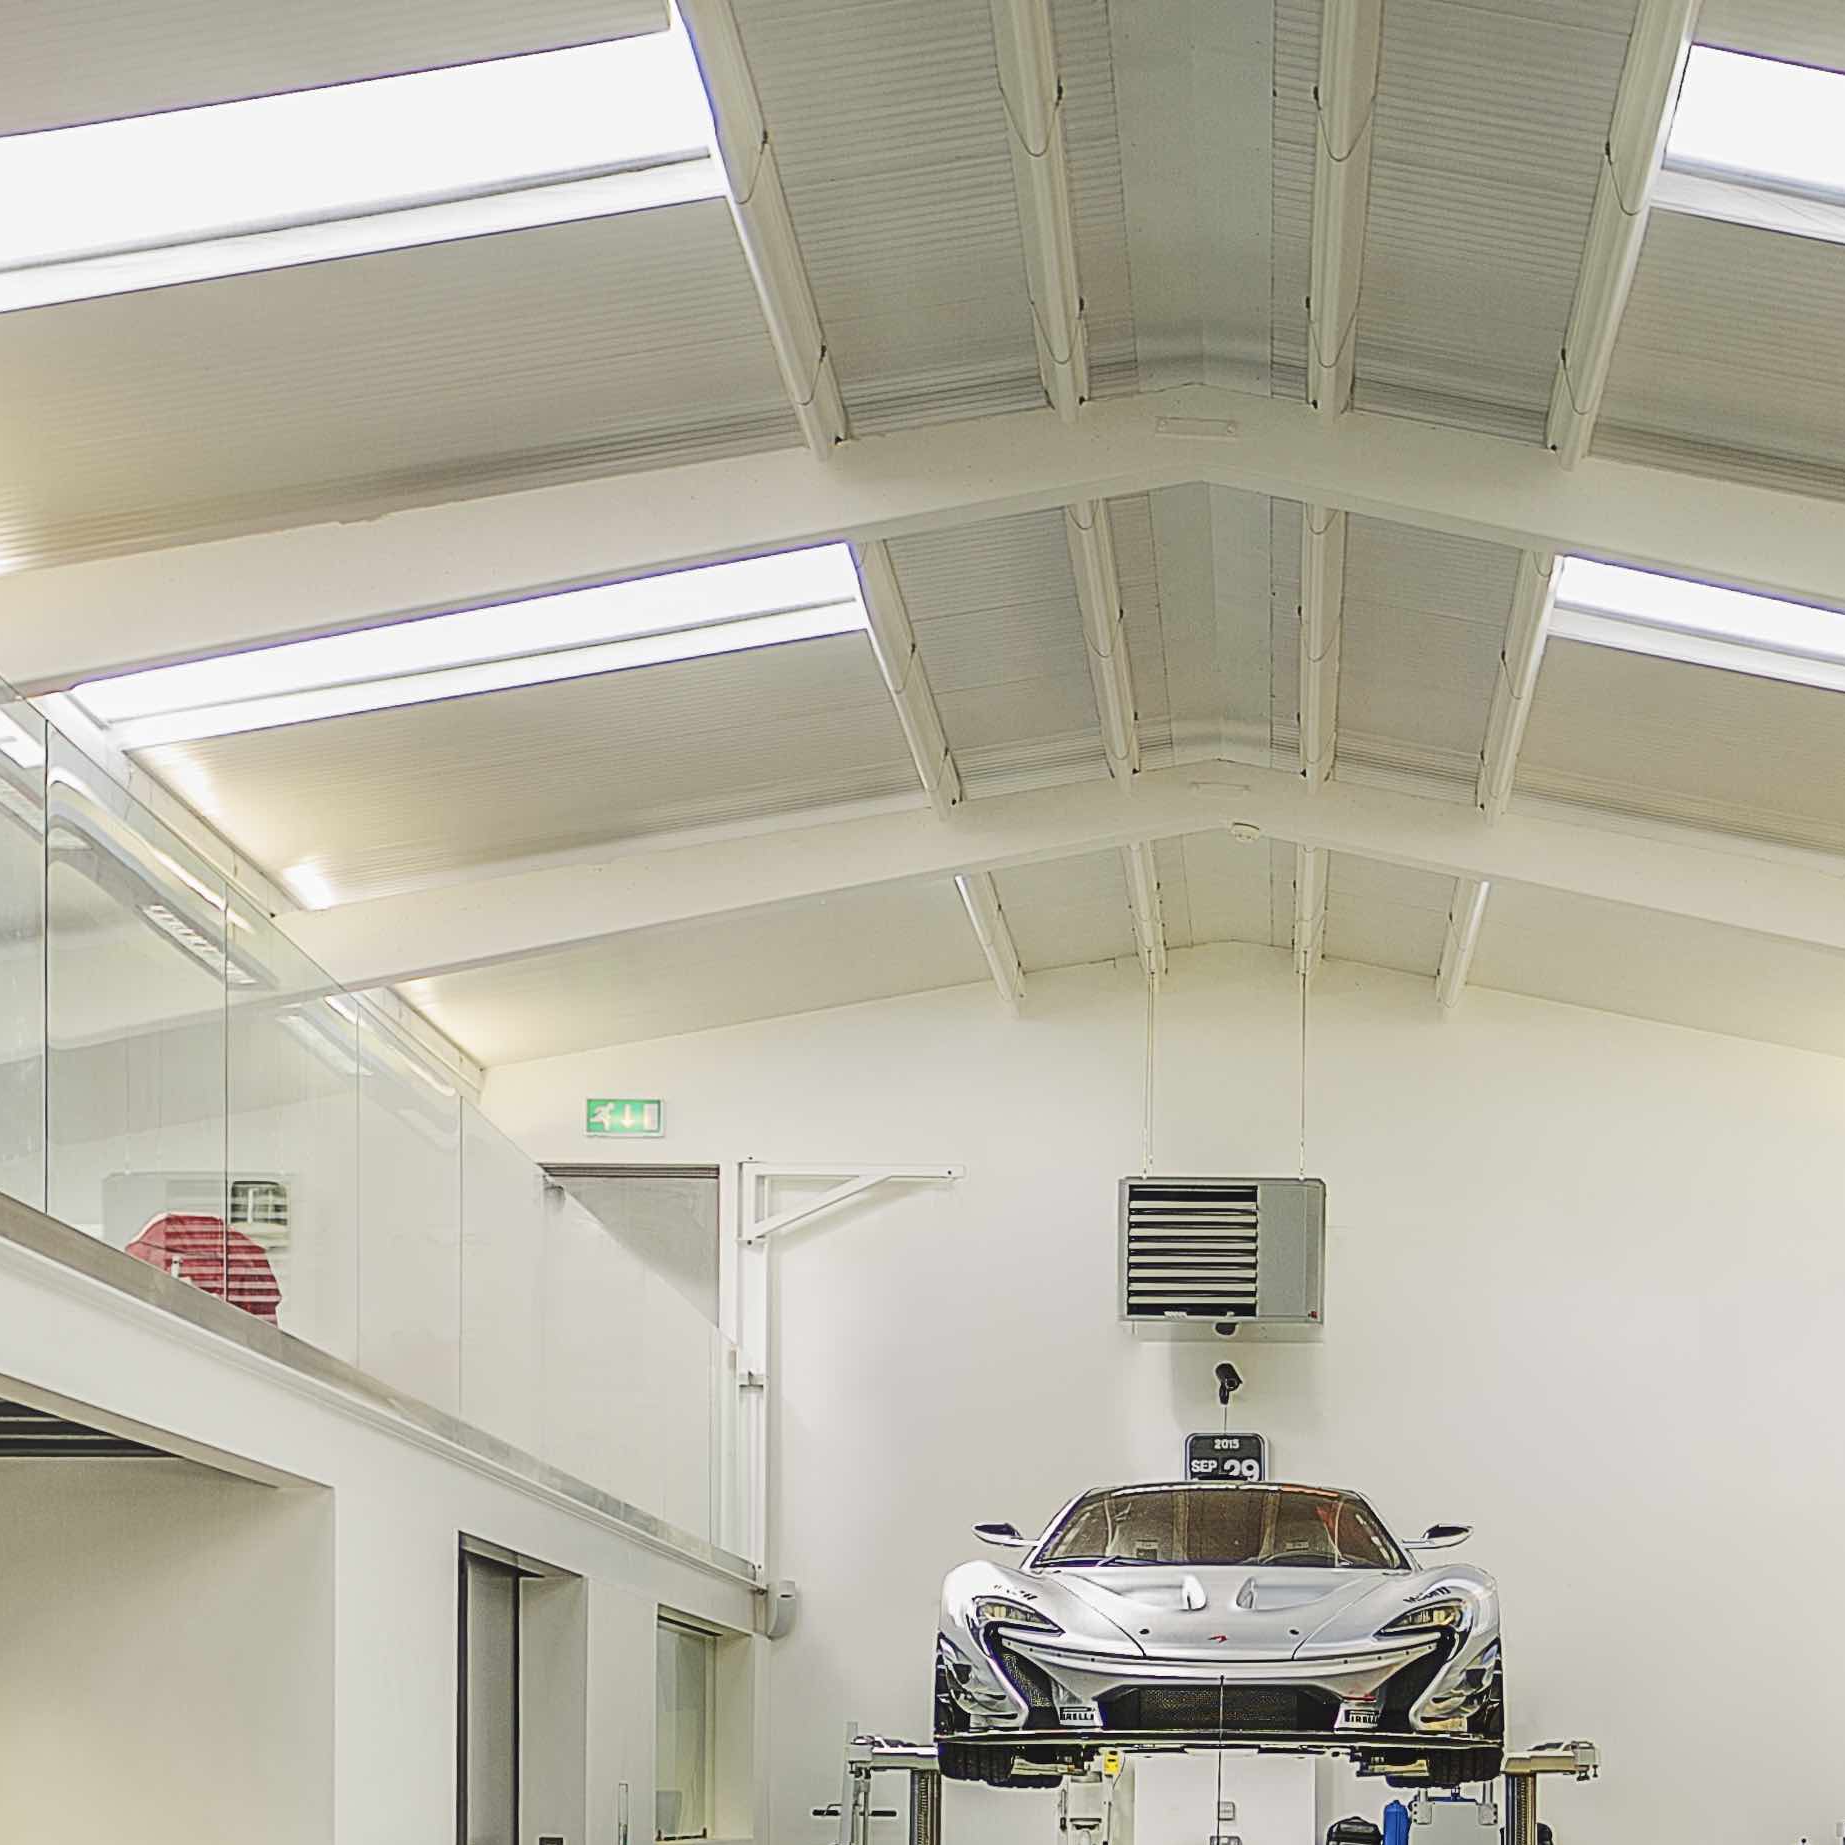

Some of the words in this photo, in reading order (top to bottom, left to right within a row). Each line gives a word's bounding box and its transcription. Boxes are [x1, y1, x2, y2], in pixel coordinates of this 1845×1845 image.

[1213, 1438, 1240, 1449] 2015
[1191, 1459, 1218, 1473] SEP
[1223, 1458, 1260, 1482] 29
